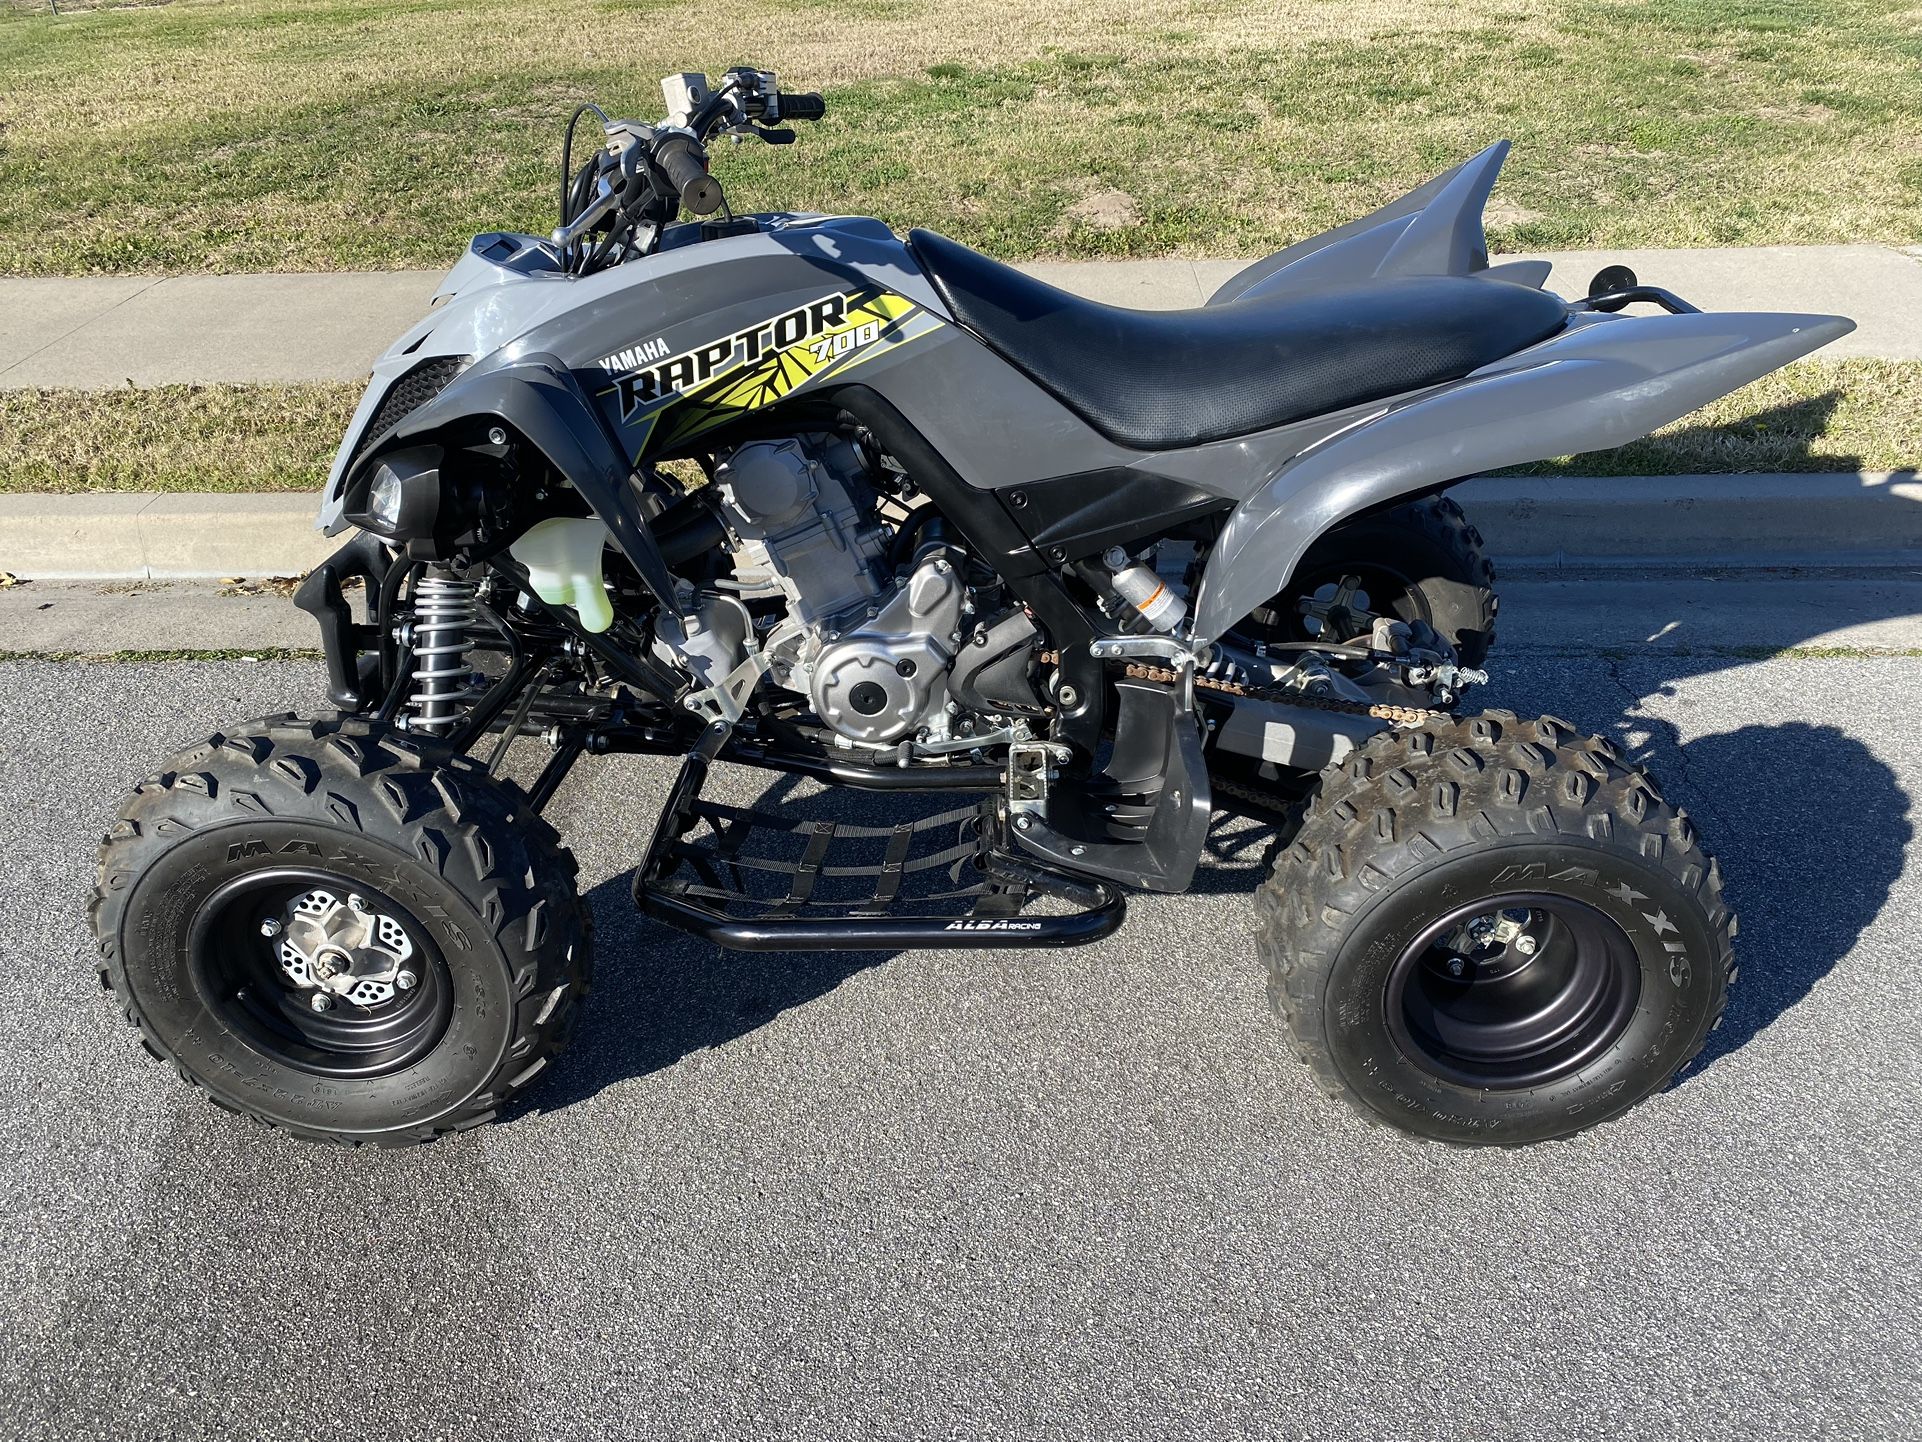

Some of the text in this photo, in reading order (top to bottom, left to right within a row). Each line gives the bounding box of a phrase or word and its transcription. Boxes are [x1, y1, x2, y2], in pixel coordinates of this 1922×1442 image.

[598, 337, 671, 376] YAMAHA
[612, 291, 851, 424] RAPTOR
[808, 318, 880, 365] 700
[226, 839, 473, 952] MAXXIS
[943, 920, 1042, 931] ALBA RACING
[1489, 862, 1693, 989] MAXXIS
